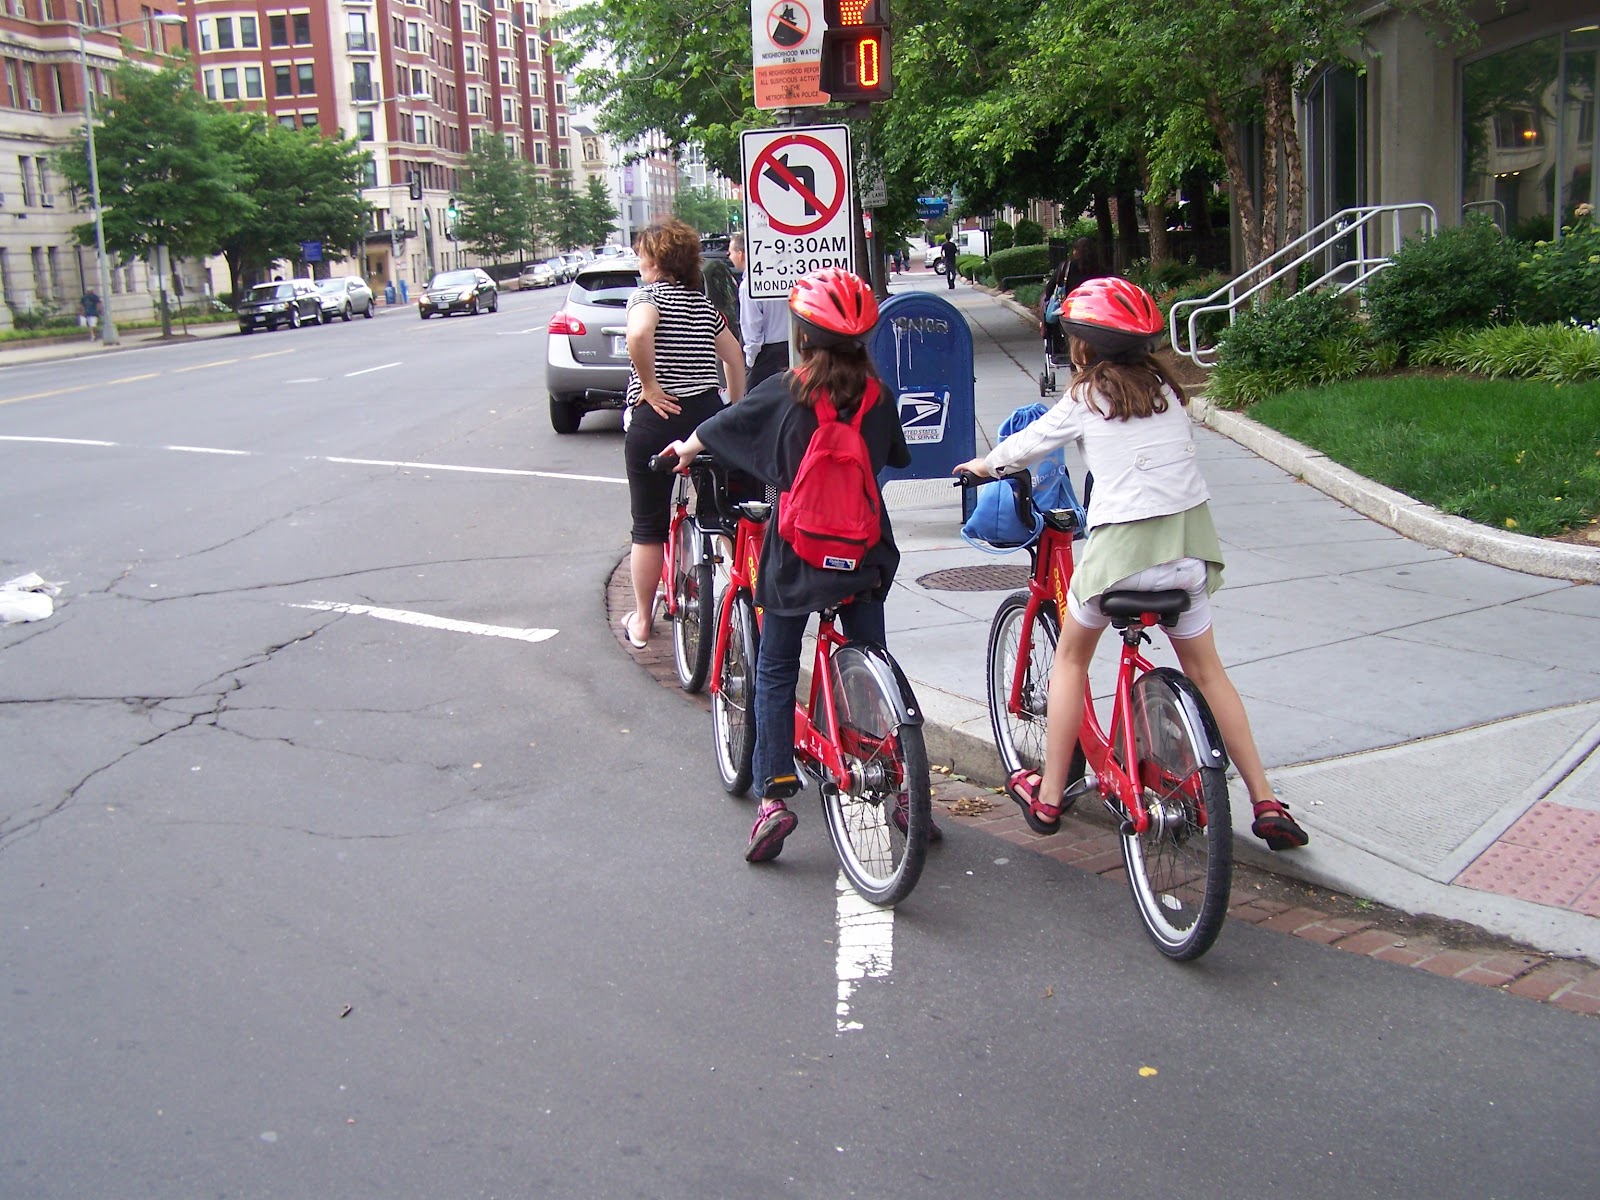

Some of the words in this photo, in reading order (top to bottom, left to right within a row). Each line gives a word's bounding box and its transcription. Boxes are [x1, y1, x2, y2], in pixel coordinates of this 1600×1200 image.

[762, 50, 798, 59] NEIGHBORHOOD
[800, 48, 820, 56] WATCH
[769, 68, 802, 76] NEIGHBORHOOD
[770, 77, 798, 85] SUSPICIOUS
[752, 236, 846, 255] 7-9:30AM
[1053, 567, 1067, 625] capita
